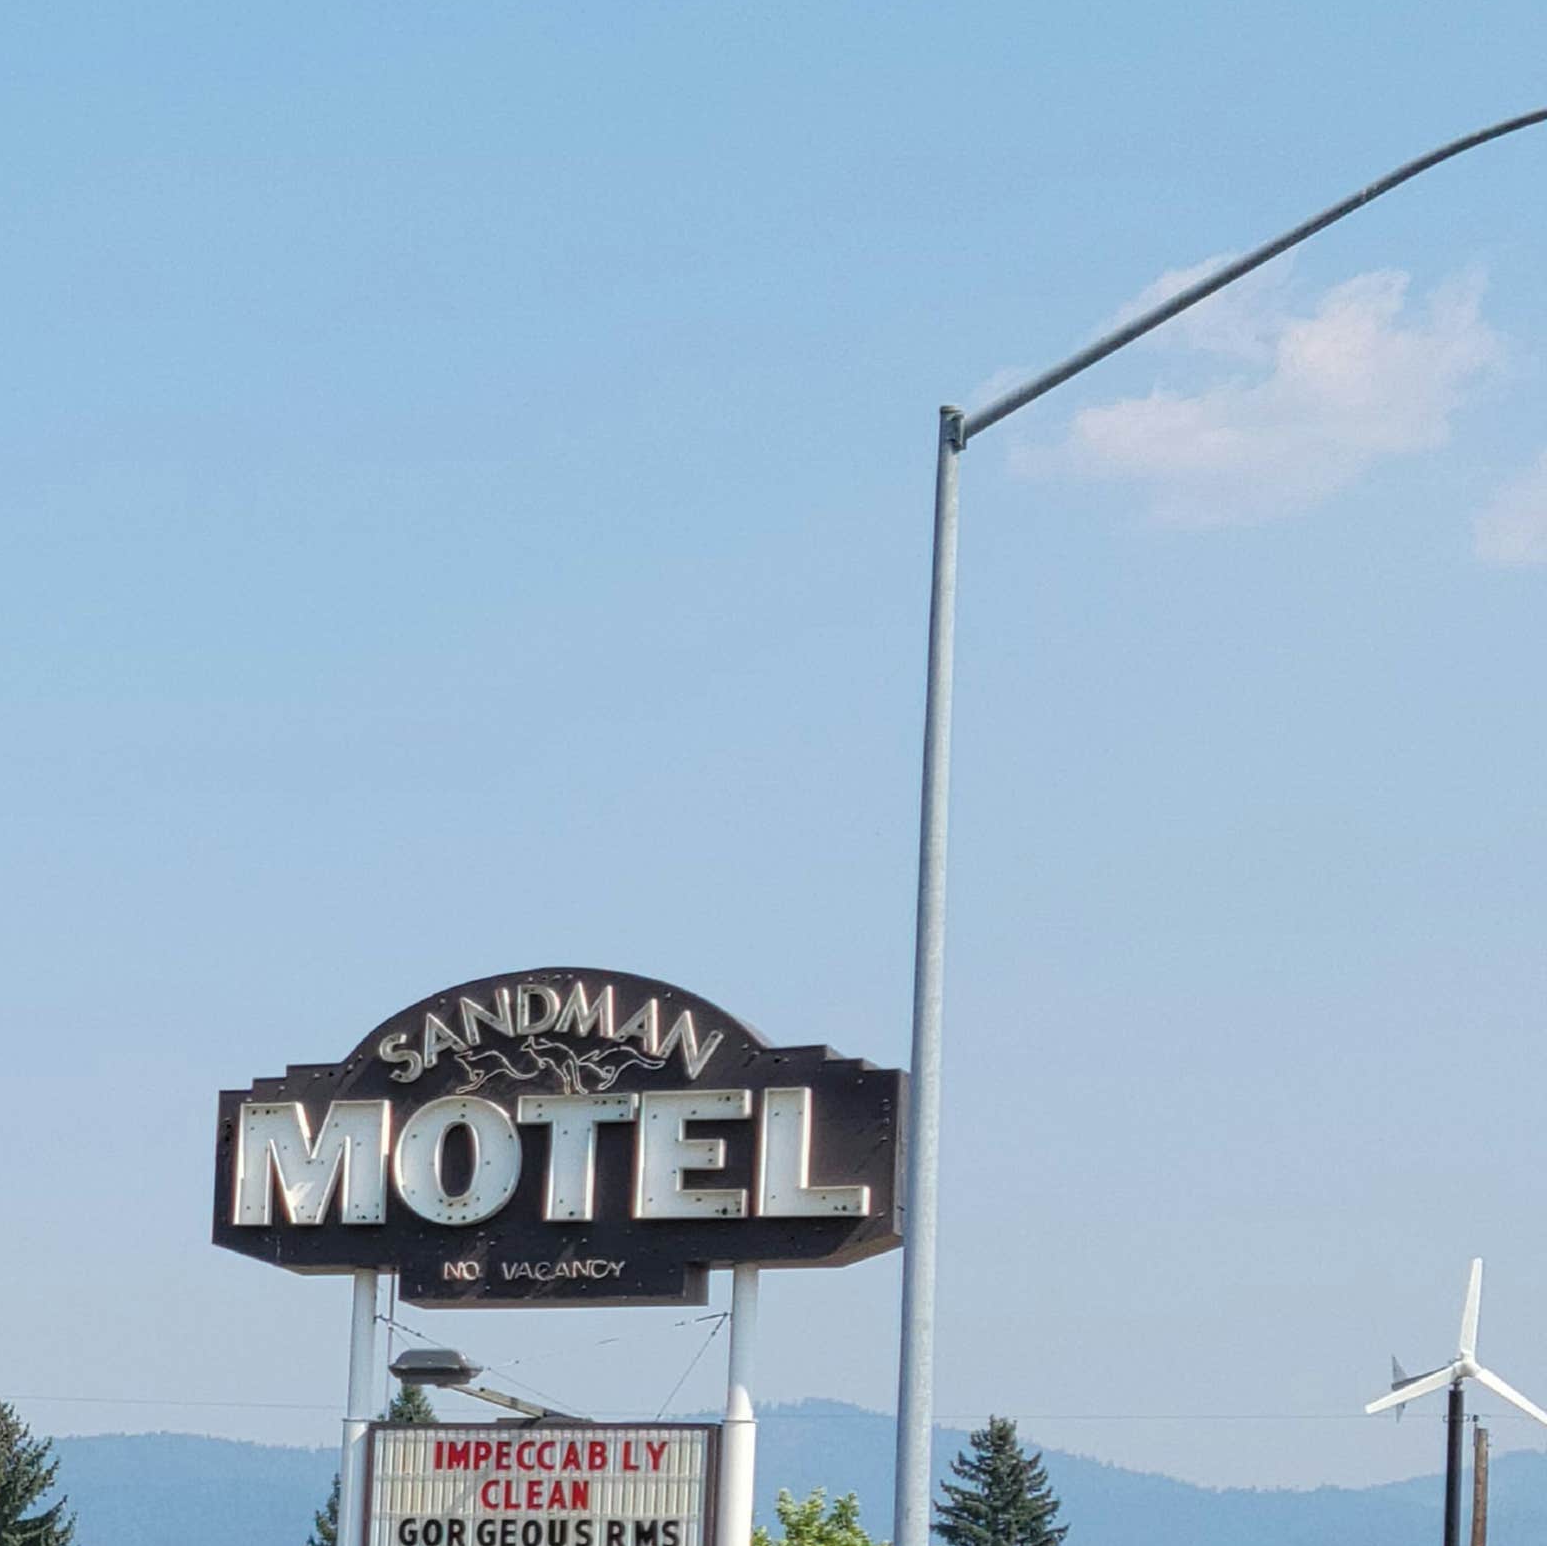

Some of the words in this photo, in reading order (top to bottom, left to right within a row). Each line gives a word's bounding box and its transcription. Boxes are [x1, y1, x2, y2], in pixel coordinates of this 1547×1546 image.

[379, 982, 724, 1083] SANDMAN
[231, 1087, 870, 1227] MOTEL
[443, 1260, 481, 1281] NO
[502, 1259, 626, 1281] VACANCY
[433, 1440, 669, 1472] IMPECCABLY
[480, 1479, 590, 1510] CLEAN
